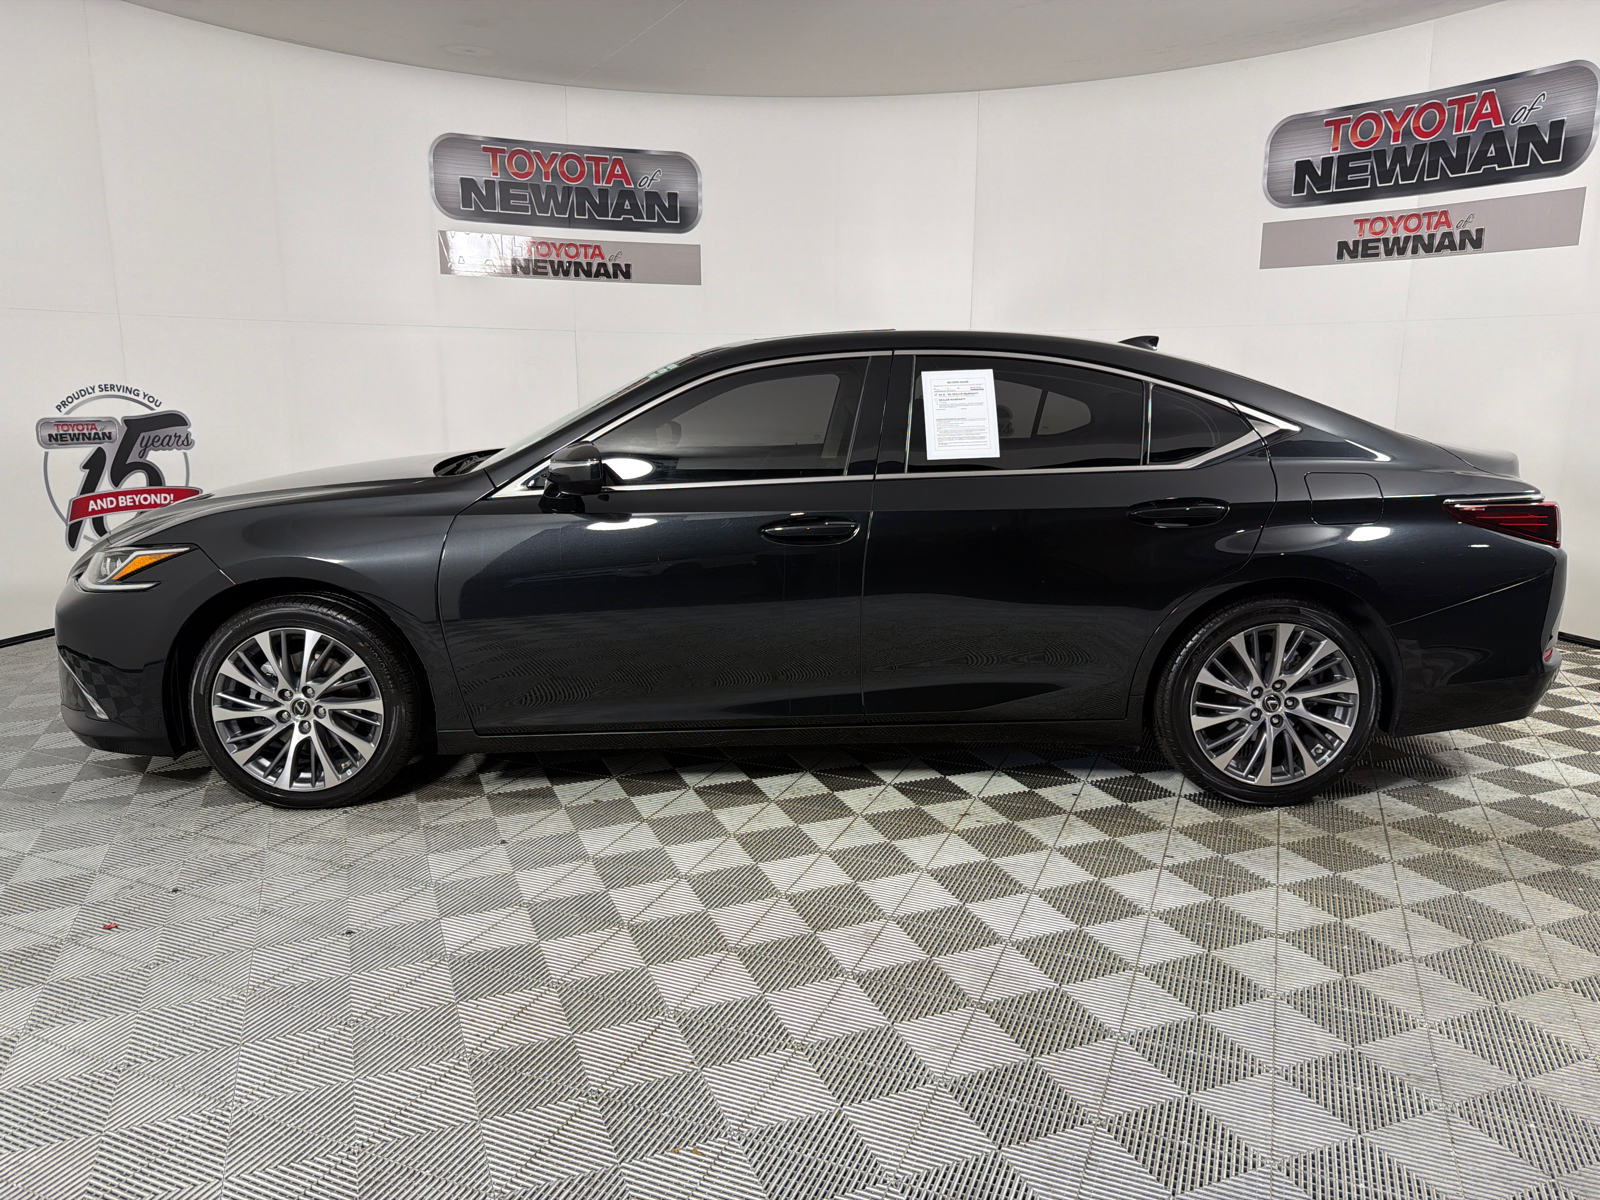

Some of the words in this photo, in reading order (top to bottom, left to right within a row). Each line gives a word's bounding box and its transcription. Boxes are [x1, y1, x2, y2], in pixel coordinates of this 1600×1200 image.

[1323, 89, 1505, 152] TOYOTA
[1510, 91, 1547, 125] of
[481, 145, 633, 187] TOYOTA
[638, 169, 662, 189] of
[1292, 117, 1567, 197] NEWNAN
[460, 177, 680, 223] NEWNAN
[1354, 209, 1453, 238] TOYOTA
[1455, 213, 1475, 229] of
[526, 240, 606, 261] TOYOTA
[608, 251, 622, 262] of
[1335, 226, 1486, 262] NEWNAN
[511, 258, 633, 280] NEWNAN
[55, 385, 97, 413] PROUDLY
[98, 383, 141, 397] SERVING
[141, 391, 162, 408] YOU
[48, 431, 112, 443] NEWNAN
[54, 423, 98, 432] TOYOTA
[138, 432, 193, 459] years
[88, 497, 117, 512] AND
[118, 493, 174, 507] BEYOND!
